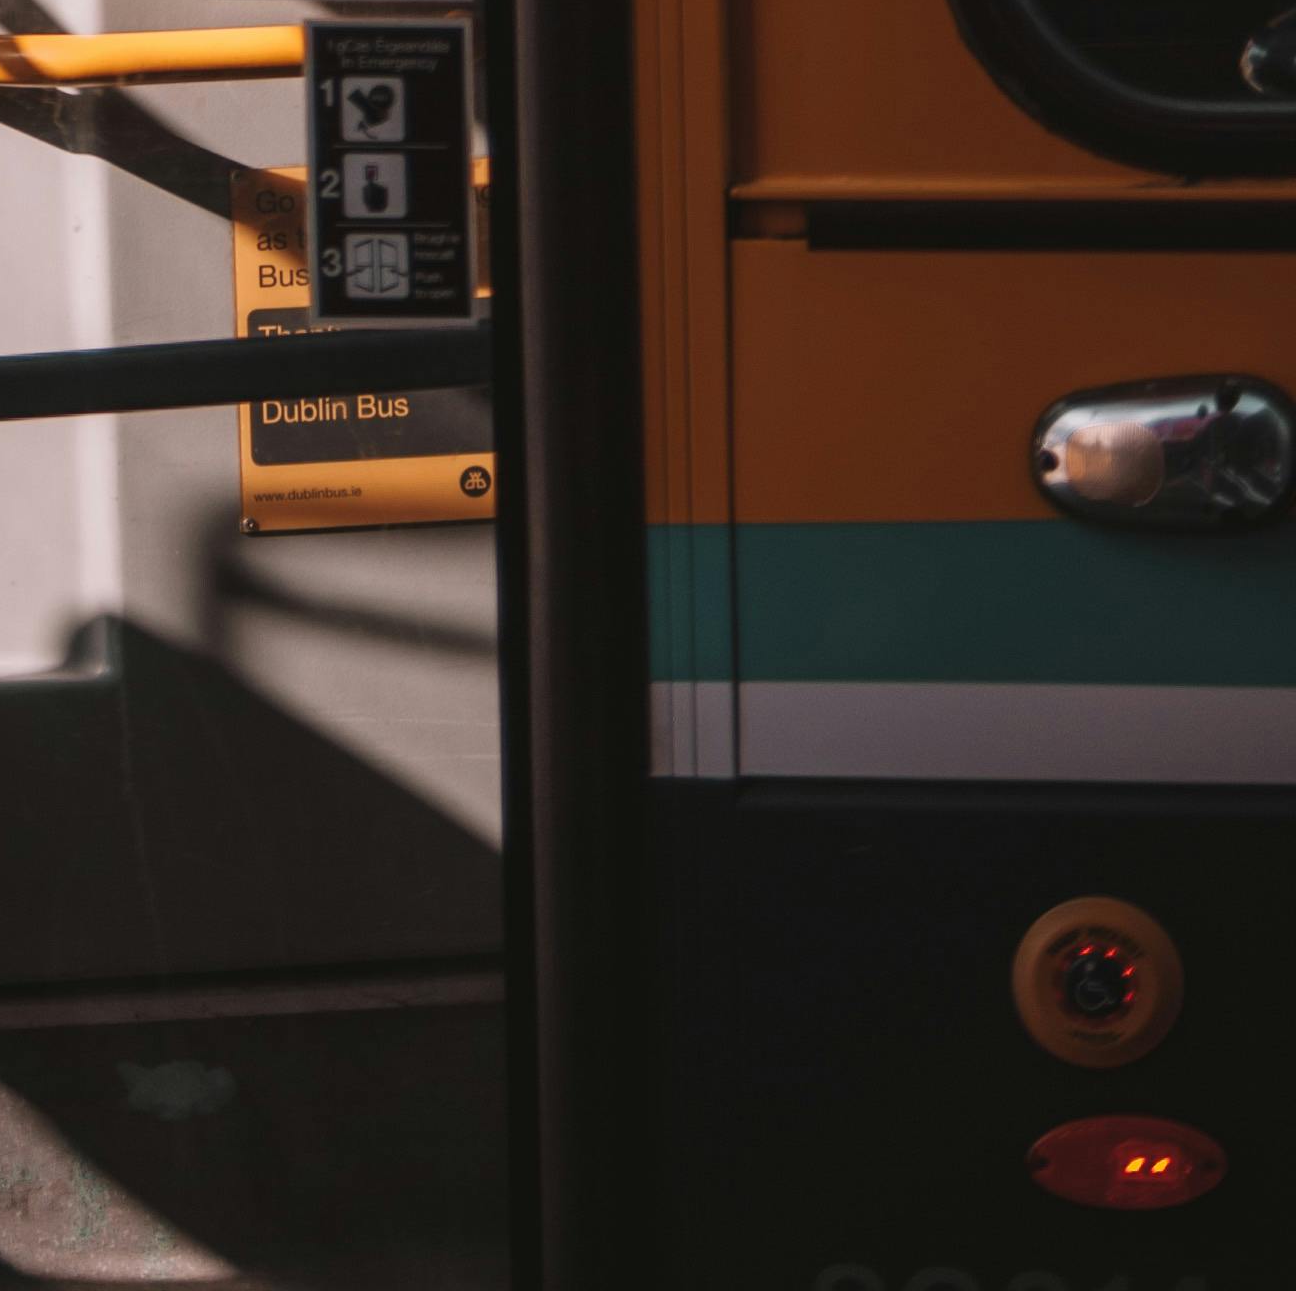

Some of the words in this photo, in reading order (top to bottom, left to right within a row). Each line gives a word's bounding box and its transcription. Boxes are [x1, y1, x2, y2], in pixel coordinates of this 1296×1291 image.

[358, 55, 440, 74] Emergency
[320, 79, 334, 107] 1
[320, 169, 340, 199] 2
[256, 189, 295, 213] Go
[256, 232, 288, 251] as
[322, 248, 343, 277] 3
[259, 264, 310, 288] Bus
[262, 397, 348, 424] Dublin
[357, 394, 410, 420] Bus
[254, 485, 362, 502] www.dublinbus.ie
